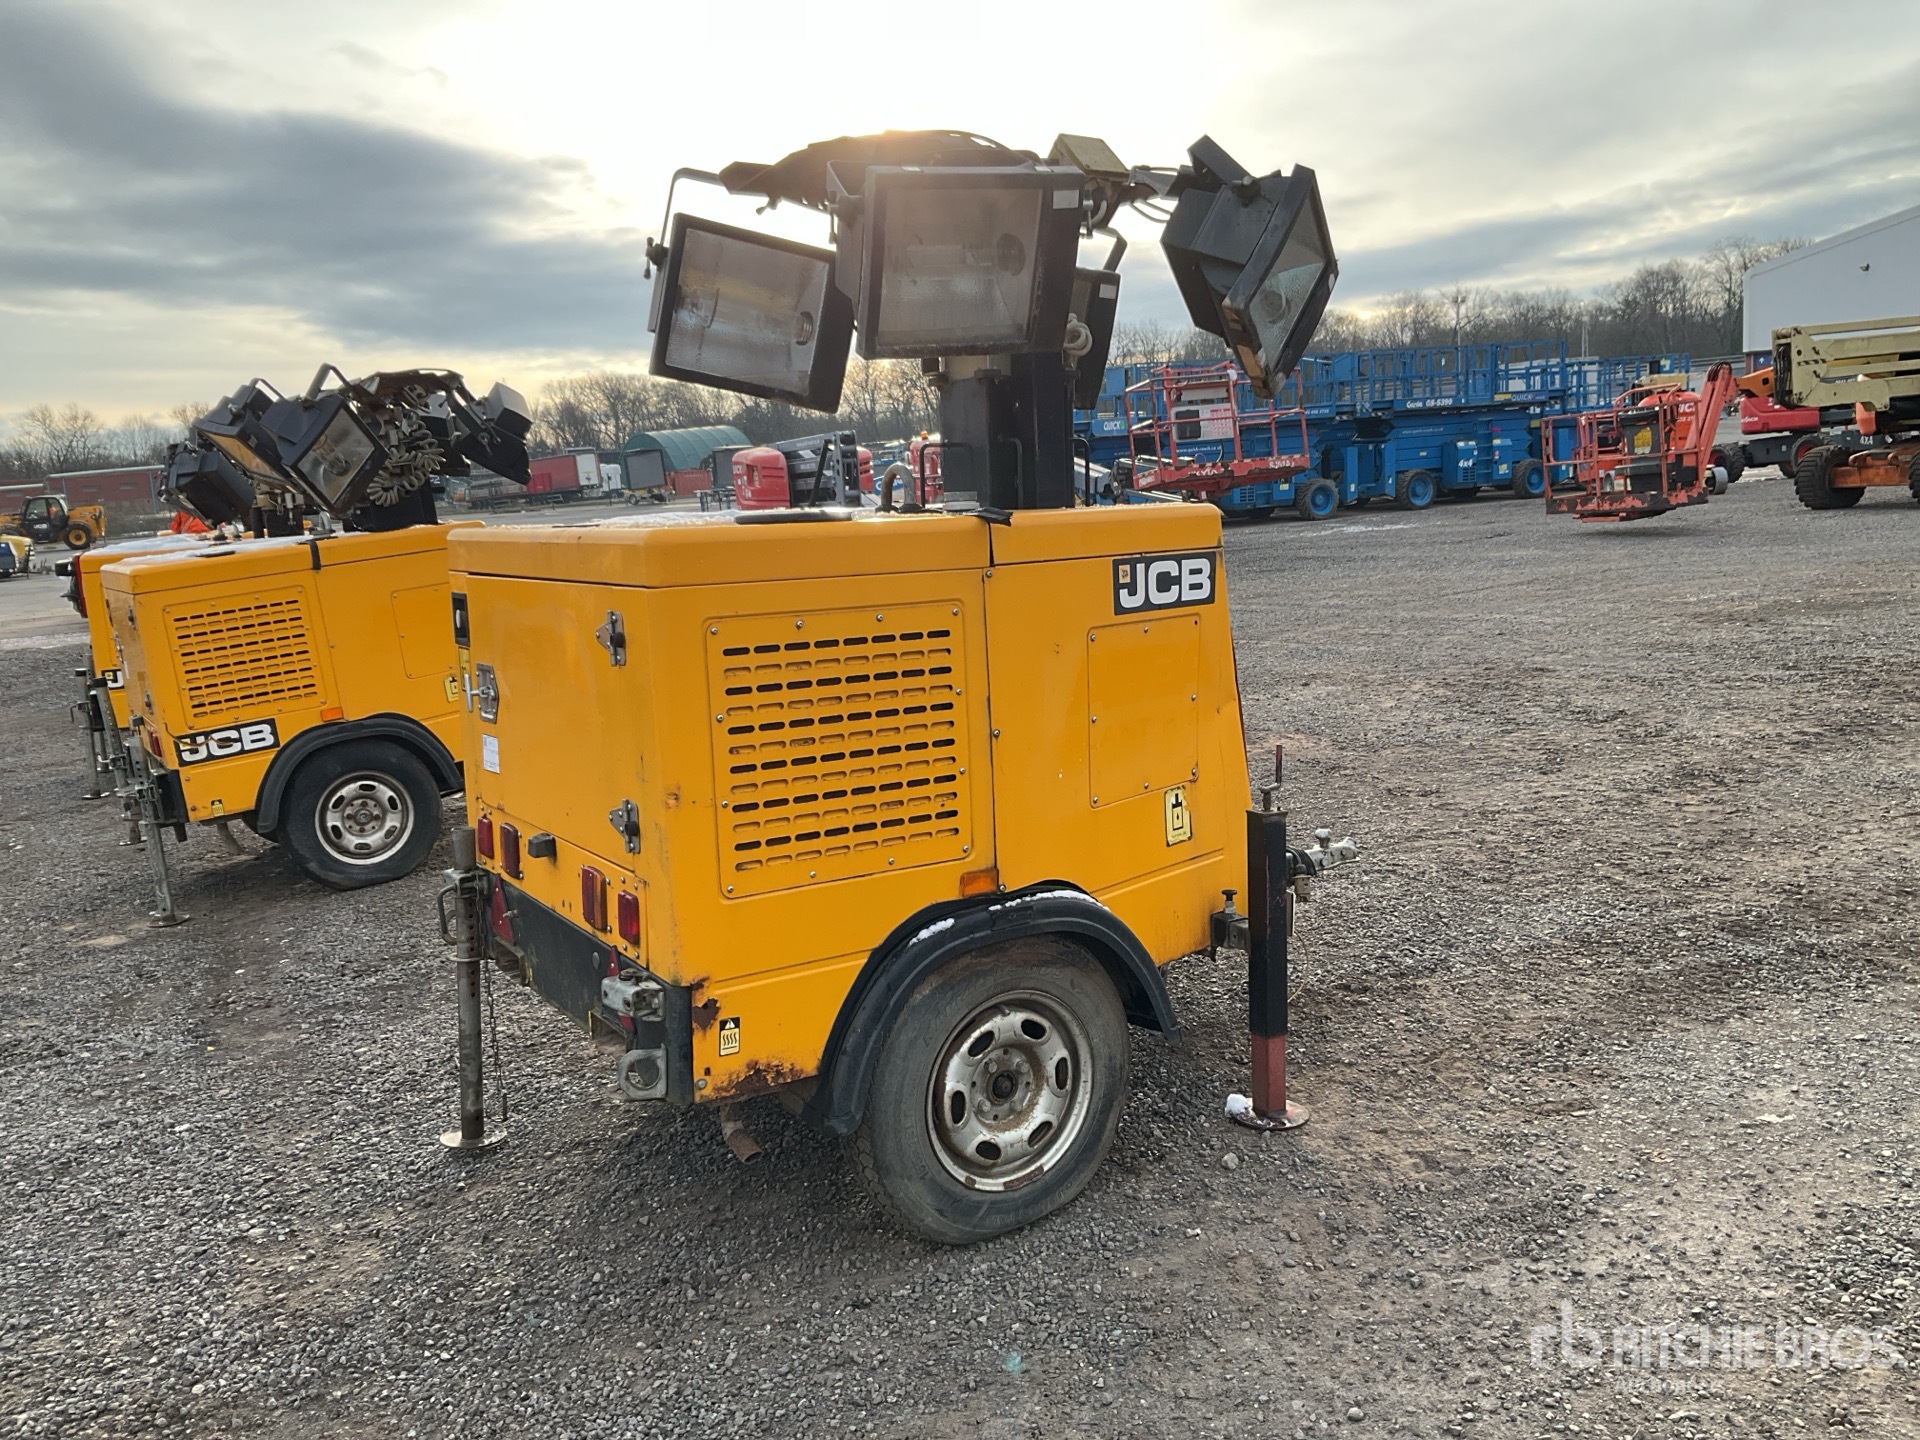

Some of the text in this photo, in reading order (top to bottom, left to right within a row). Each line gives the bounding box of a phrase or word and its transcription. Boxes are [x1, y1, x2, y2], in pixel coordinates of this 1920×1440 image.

[1103, 421, 1120, 431] QUICK
[1118, 557, 1211, 608] JCB
[180, 723, 275, 762] JCB
